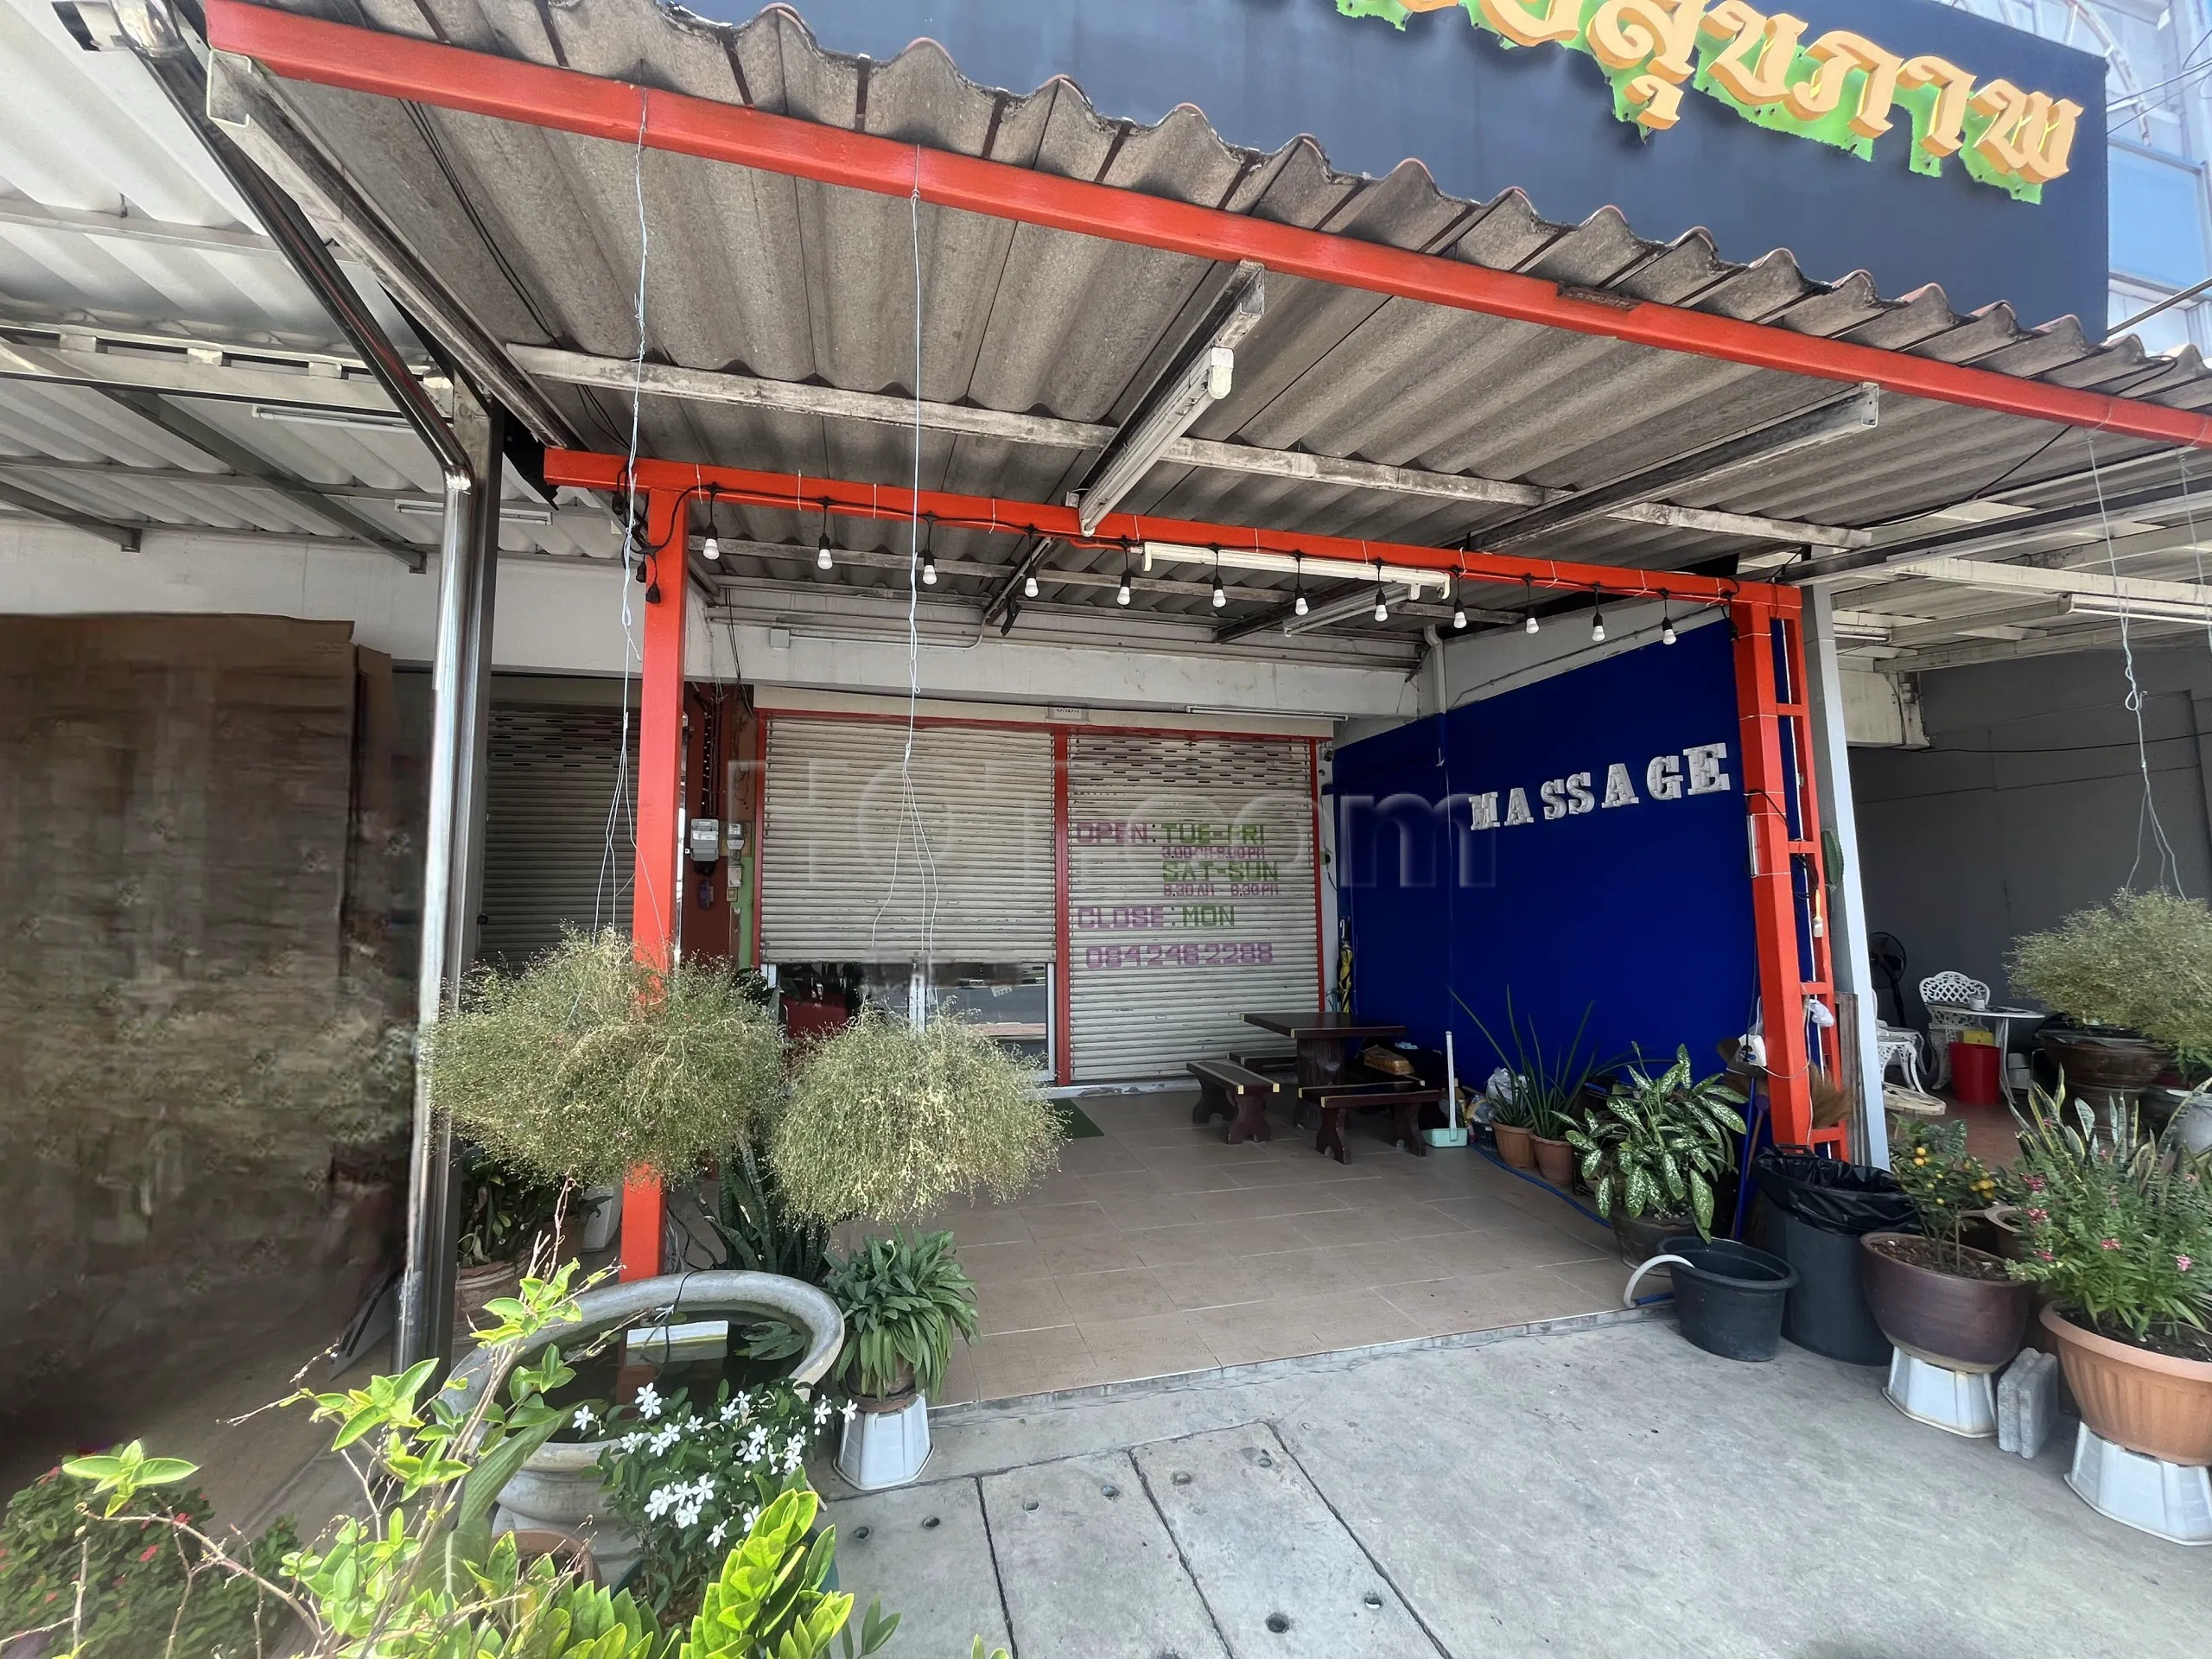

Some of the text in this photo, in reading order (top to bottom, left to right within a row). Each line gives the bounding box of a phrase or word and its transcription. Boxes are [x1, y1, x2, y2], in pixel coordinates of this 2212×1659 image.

[1404, 0, 2083, 195] สุขภาพ
[1469, 742, 1731, 831] MASSAGE
[1161, 823, 1265, 845] TUE-FRI
[1162, 861, 1279, 882] SAT-SUN
[1182, 905, 1236, 927] MON
